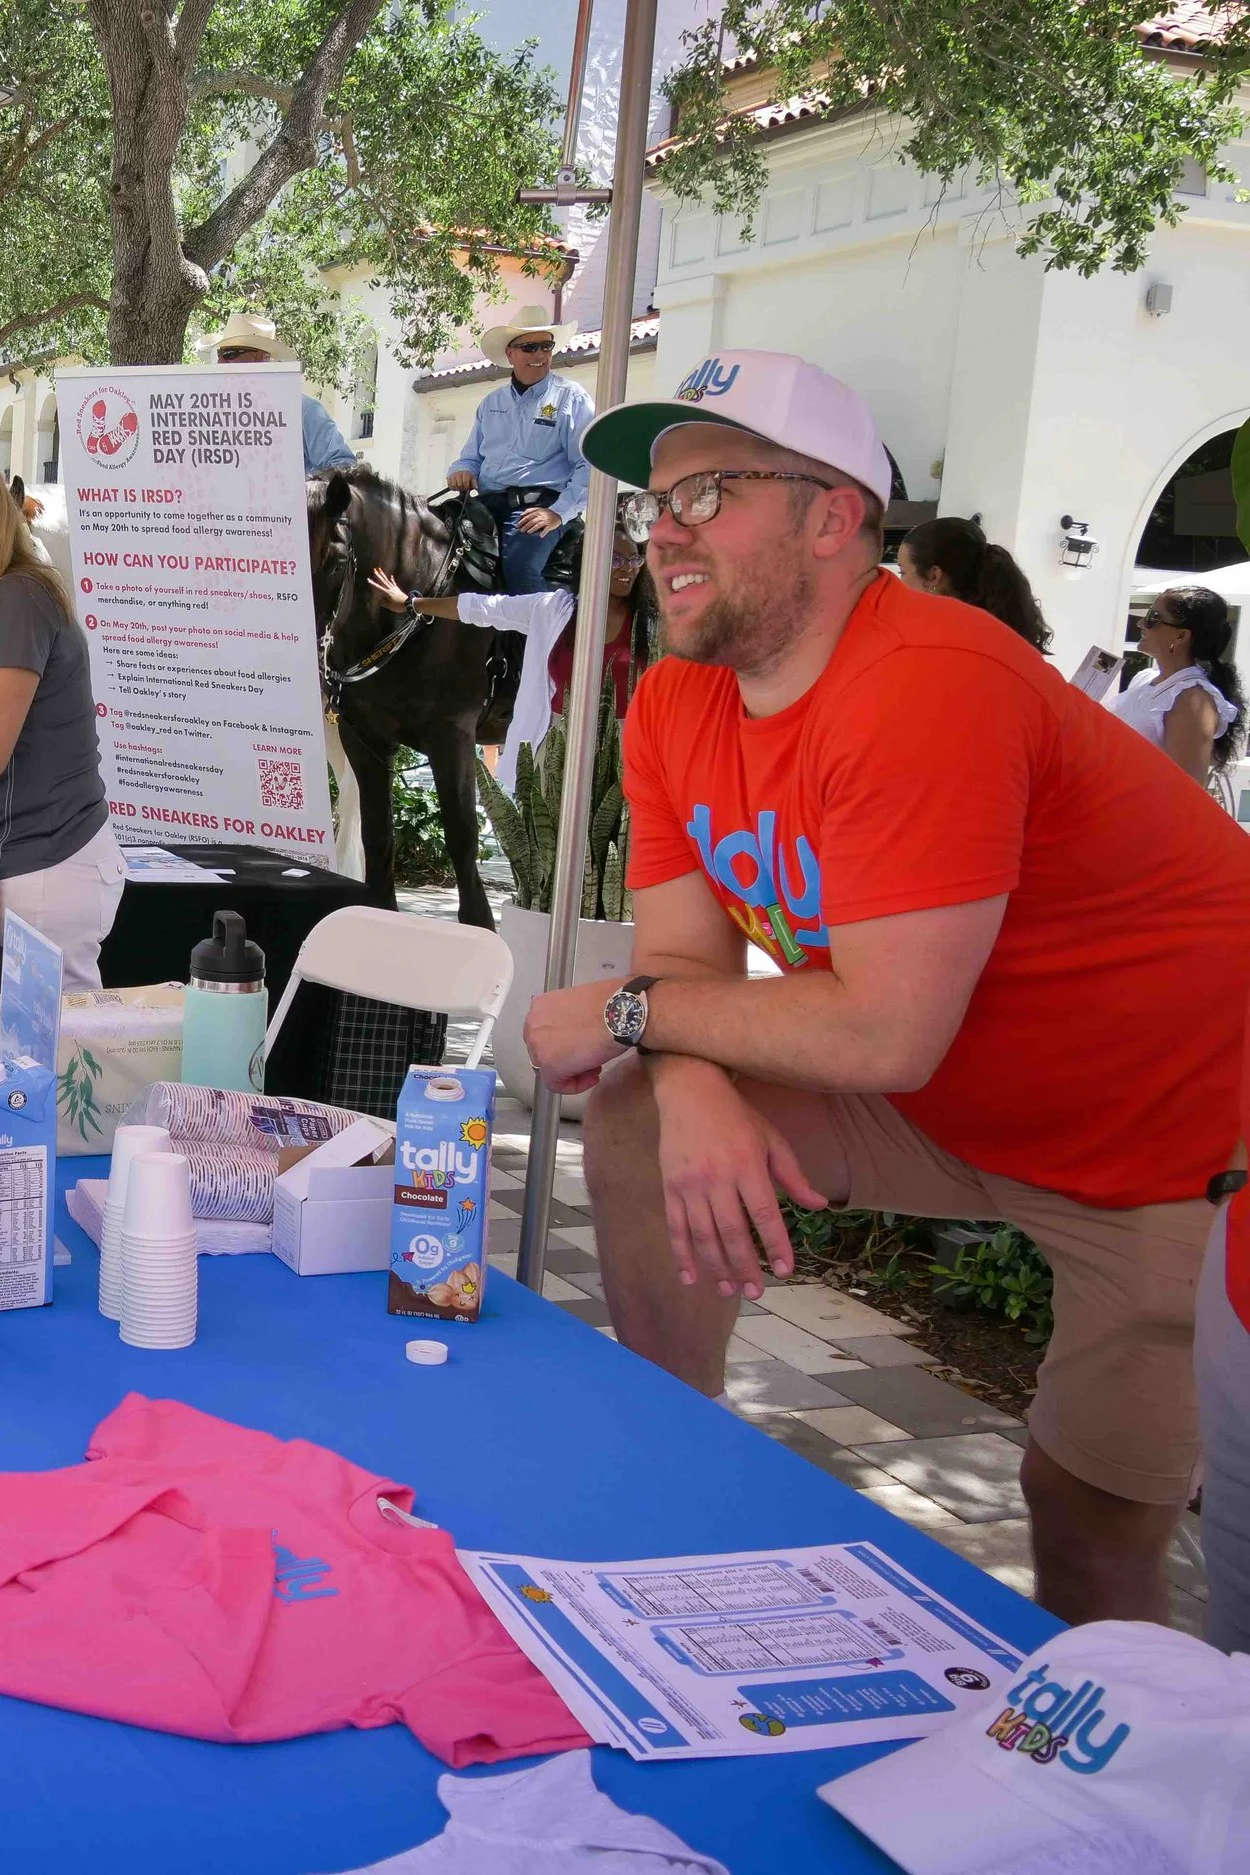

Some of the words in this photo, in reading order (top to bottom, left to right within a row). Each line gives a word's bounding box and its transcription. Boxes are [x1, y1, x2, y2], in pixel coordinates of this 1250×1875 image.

[672, 357, 740, 399] ally
[77, 389, 99, 418] Sneakers
[108, 386, 131, 404] Oakley
[150, 393, 184, 409] MAY
[190, 393, 231, 409] 20TH
[238, 392, 252, 409] IS
[151, 411, 287, 428] INTERNATIONAL
[152, 430, 182, 446] RED
[187, 430, 273, 446] SNEAKERS
[153, 449, 186, 464] DAY
[191, 448, 240, 469] (IRSD)
[77, 488, 119, 503] WHAT
[124, 488, 136, 503] IS
[141, 488, 182, 504] IRSD?
[79, 509, 90, 517] It's
[104, 510, 151, 520] opportunity
[187, 511, 224, 522] together
[245, 515, 292, 525] community
[93, 523, 109, 533] May
[111, 524, 129, 532] 20th
[142, 525, 170, 534] spread
[172, 525, 191, 534] food
[193, 526, 223, 537] allergy
[225, 529, 273, 538] awareness!
[84, 552, 118, 566] HOW
[123, 553, 154, 568] CAN
[157, 555, 189, 569] YOU
[195, 556, 297, 575] PARTICIPATE?
[121, 584, 143, 593] photo
[145, 584, 153, 592] of
[154, 586, 184, 595] yourself
[185, 587, 193, 595] in
[276, 592, 298, 601] RSFO
[98, 596, 146, 607] merchandise,
[158, 600, 191, 610] anything
[192, 601, 209, 609] red!
[102, 634, 126, 642] spread
[127, 635, 145, 643] food
[146, 637, 172, 647] allergy
[174, 640, 218, 648] awareness!
[113, 621, 129, 630] May
[130, 622, 149, 631] 20th,
[151, 624, 167, 632] post
[169, 626, 186, 634] your
[188, 626, 211, 636] photo
[224, 629, 246, 637] social
[247, 631, 271, 639] media
[282, 633, 299, 643] help
[103, 646, 120, 654] Here
[156, 650, 179, 659] ideas:
[116, 660, 137, 669] Share
[139, 661, 156, 670] facts
[167, 665, 212, 675] experiences
[214, 668, 237, 676] about
[238, 669, 256, 679] food
[257, 672, 291, 684] allergies
[118, 673, 145, 682] Explain
[146, 676, 193, 687] International
[195, 680, 209, 688] Red
[211, 681, 247, 692] Sneakers
[248, 685, 264, 695] Day
[119, 686, 131, 694] Tell
[168, 691, 187, 701] story
[109, 708, 123, 717] Tag
[124, 709, 210, 727] @redsneakersforoakley
[223, 720, 260, 731] Facebook
[262, 724, 268, 732] &
[269, 725, 314, 736] Instagram.
[111, 721, 124, 730] Tag
[125, 721, 172, 735] @oakley_red
[184, 729, 212, 739] Twitter.
[113, 741, 127, 749] Use
[128, 743, 163, 754] hashtags:
[253, 743, 277, 753] LEARN
[280, 747, 302, 755] MORE
[115, 754, 224, 775] #internationalredsneakersday
[117, 767, 200, 785] #redsneakersforoakley
[118, 779, 203, 797] #foodallergyawareness
[109, 801, 136, 817] RED
[141, 805, 219, 829] SNEAKERS
[223, 817, 255, 835] FOR
[260, 822, 326, 844] OAKLEY
[125, 825, 153, 835] Sneakers
[164, 830, 187, 841] Oakley
[301, 1118, 310, 1136] Cups
[309, 1117, 318, 1138] Paper
[400, 1140, 478, 1184] tally
[411, 1170, 456, 1189] KIDS
[401, 1191, 444, 1203] Chocolate
[1006, 1663, 1131, 1775] tally
[986, 1707, 1069, 1765] KIDS
